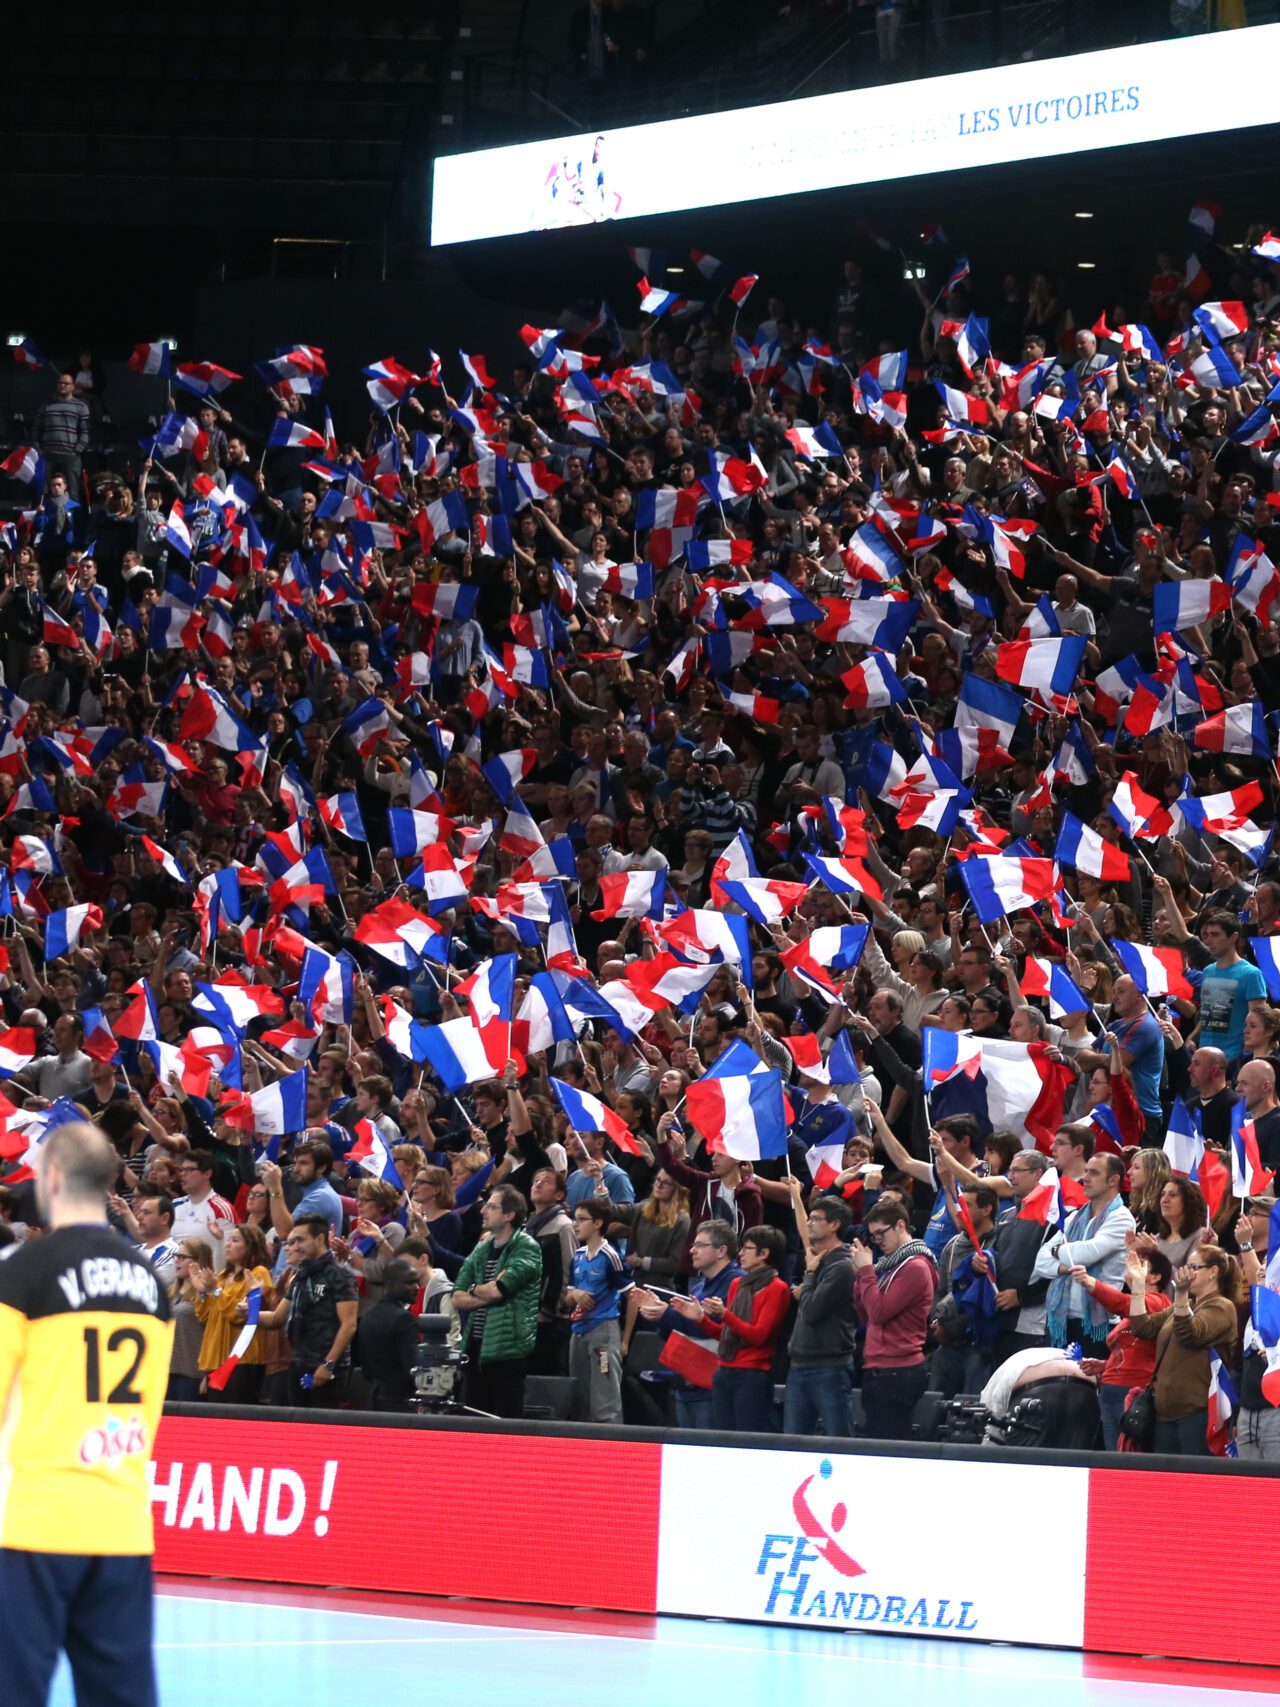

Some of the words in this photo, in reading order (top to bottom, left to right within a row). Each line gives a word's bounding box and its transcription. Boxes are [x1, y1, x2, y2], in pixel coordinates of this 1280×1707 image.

[958, 107, 1000, 137] LES
[1007, 85, 1140, 128] VICTOIRES
[84, 1328, 145, 1404] 12
[756, 1534, 819, 1577] FF
